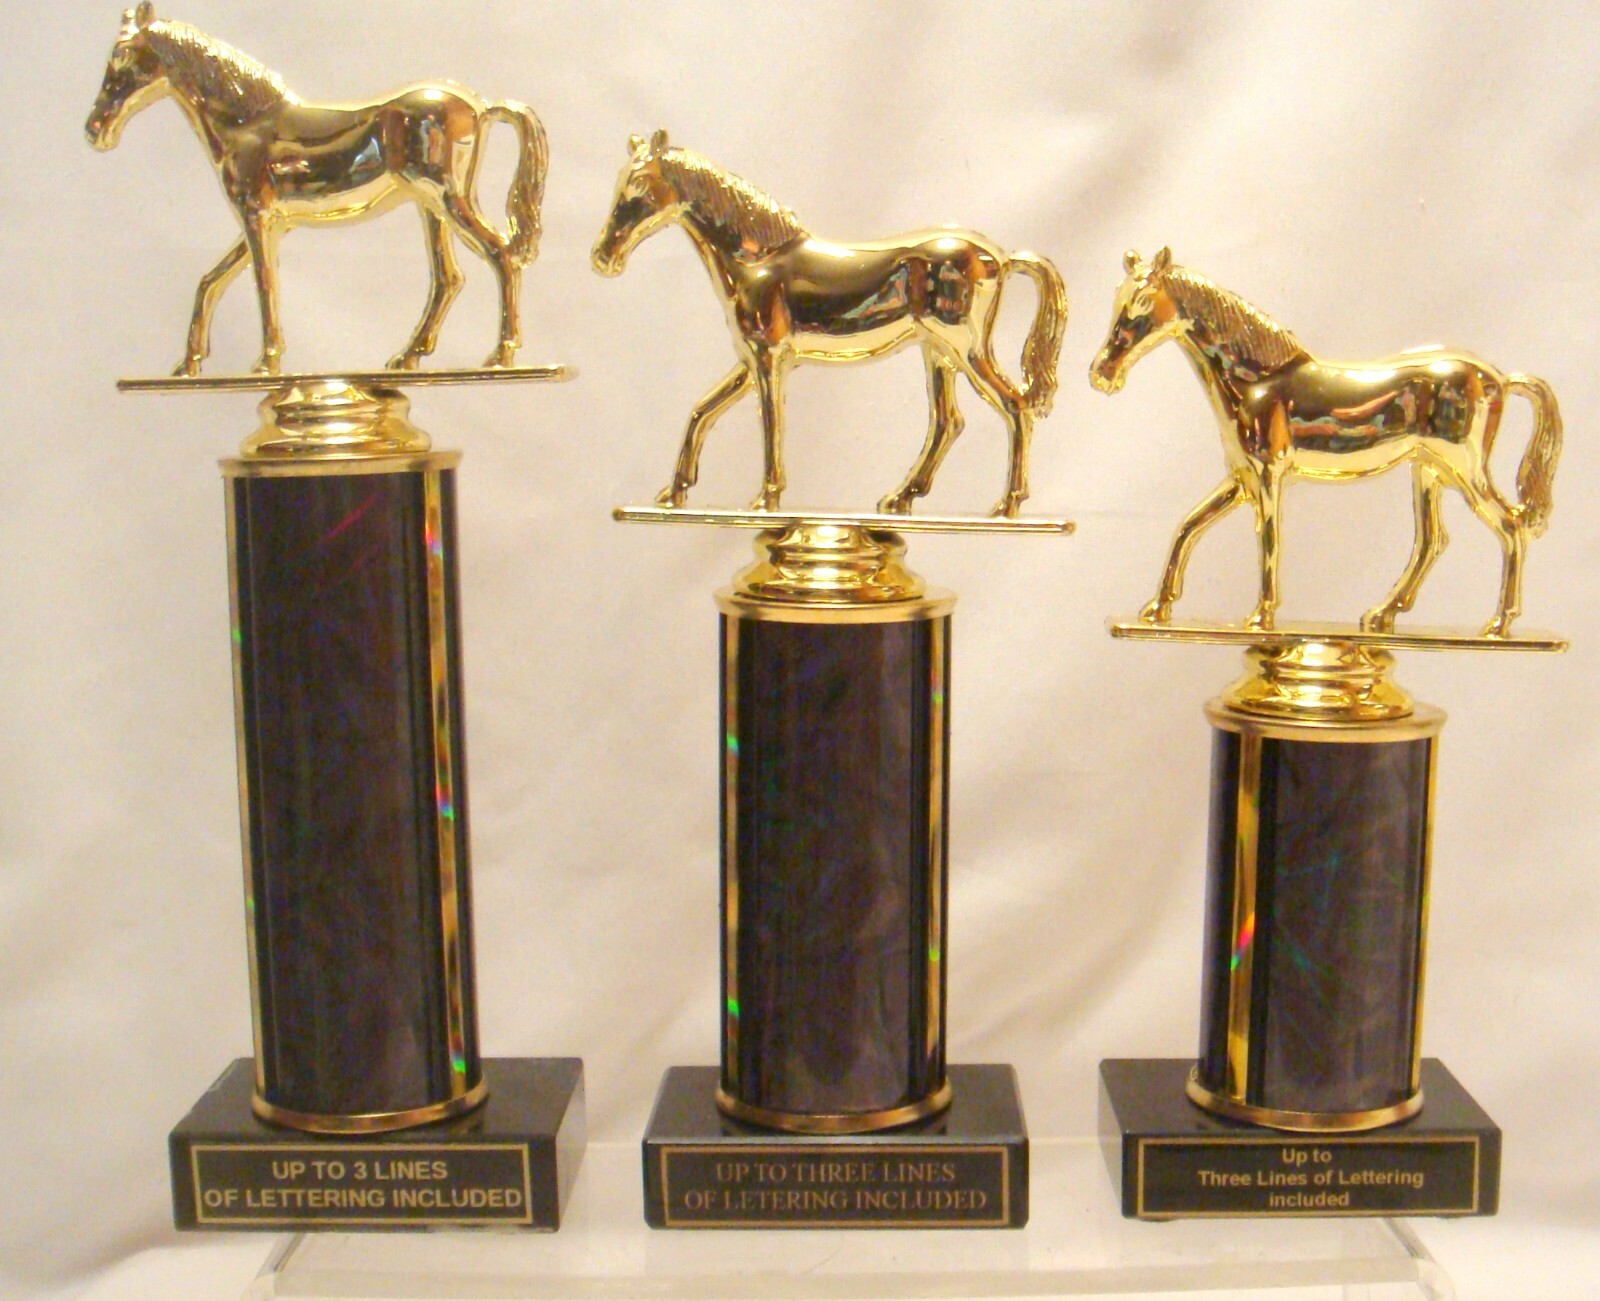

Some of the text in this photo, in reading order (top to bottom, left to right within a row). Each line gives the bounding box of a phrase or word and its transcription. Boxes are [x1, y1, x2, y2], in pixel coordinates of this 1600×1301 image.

[1282, 1148, 1332, 1167] Up to
[272, 1160, 449, 1180] UP TO 3 LINES
[715, 1163, 956, 1183] UP TO THREE LINES
[1198, 1169, 1425, 1187] Three Lines of Lettering
[204, 1188, 523, 1208] OF LETTERING INCLUDED
[684, 1190, 717, 1210] OF
[855, 1190, 988, 1210] INCLUDED
[1269, 1192, 1350, 1208] included
